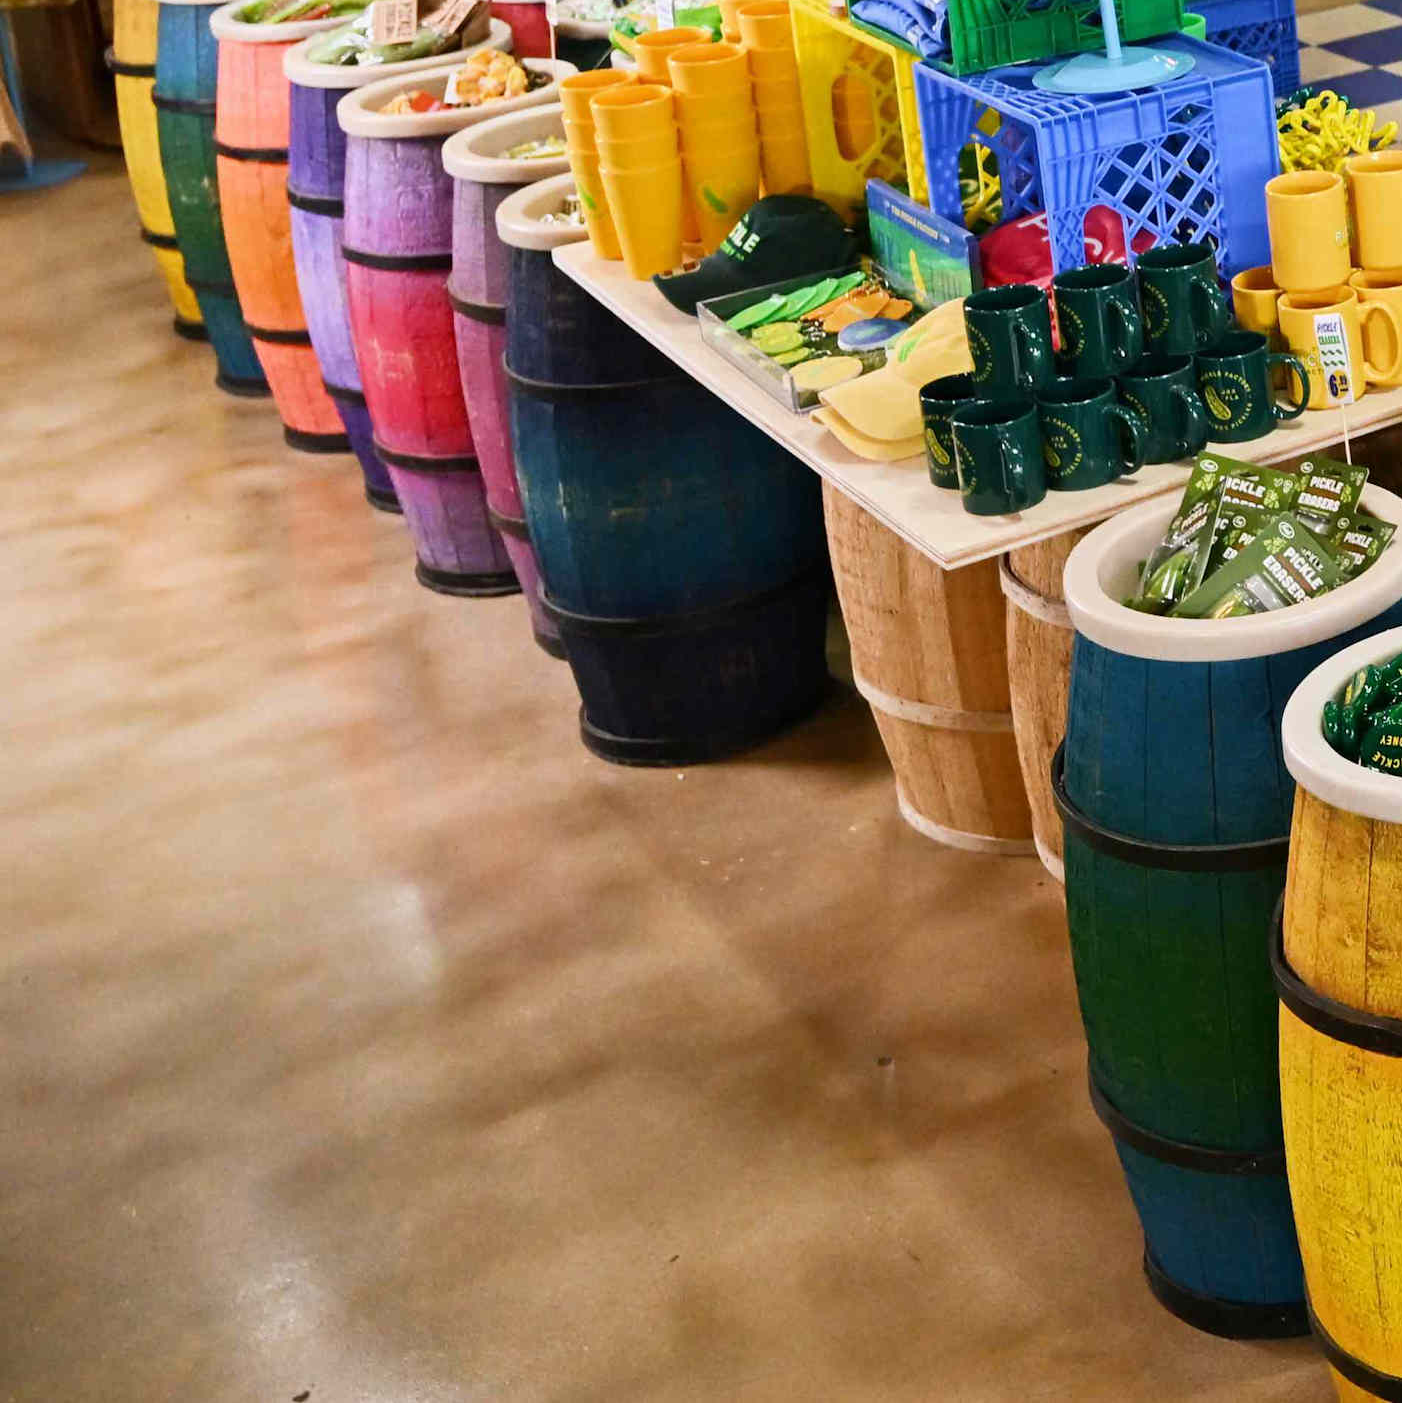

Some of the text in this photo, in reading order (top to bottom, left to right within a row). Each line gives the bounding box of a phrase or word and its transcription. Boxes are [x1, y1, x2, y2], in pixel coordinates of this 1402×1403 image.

[1309, 475, 1345, 493] PICKLE
[1297, 493, 1342, 513] ERASERS
[1343, 531, 1374, 550] PICKLE
[1282, 547, 1325, 592] PICKLE
